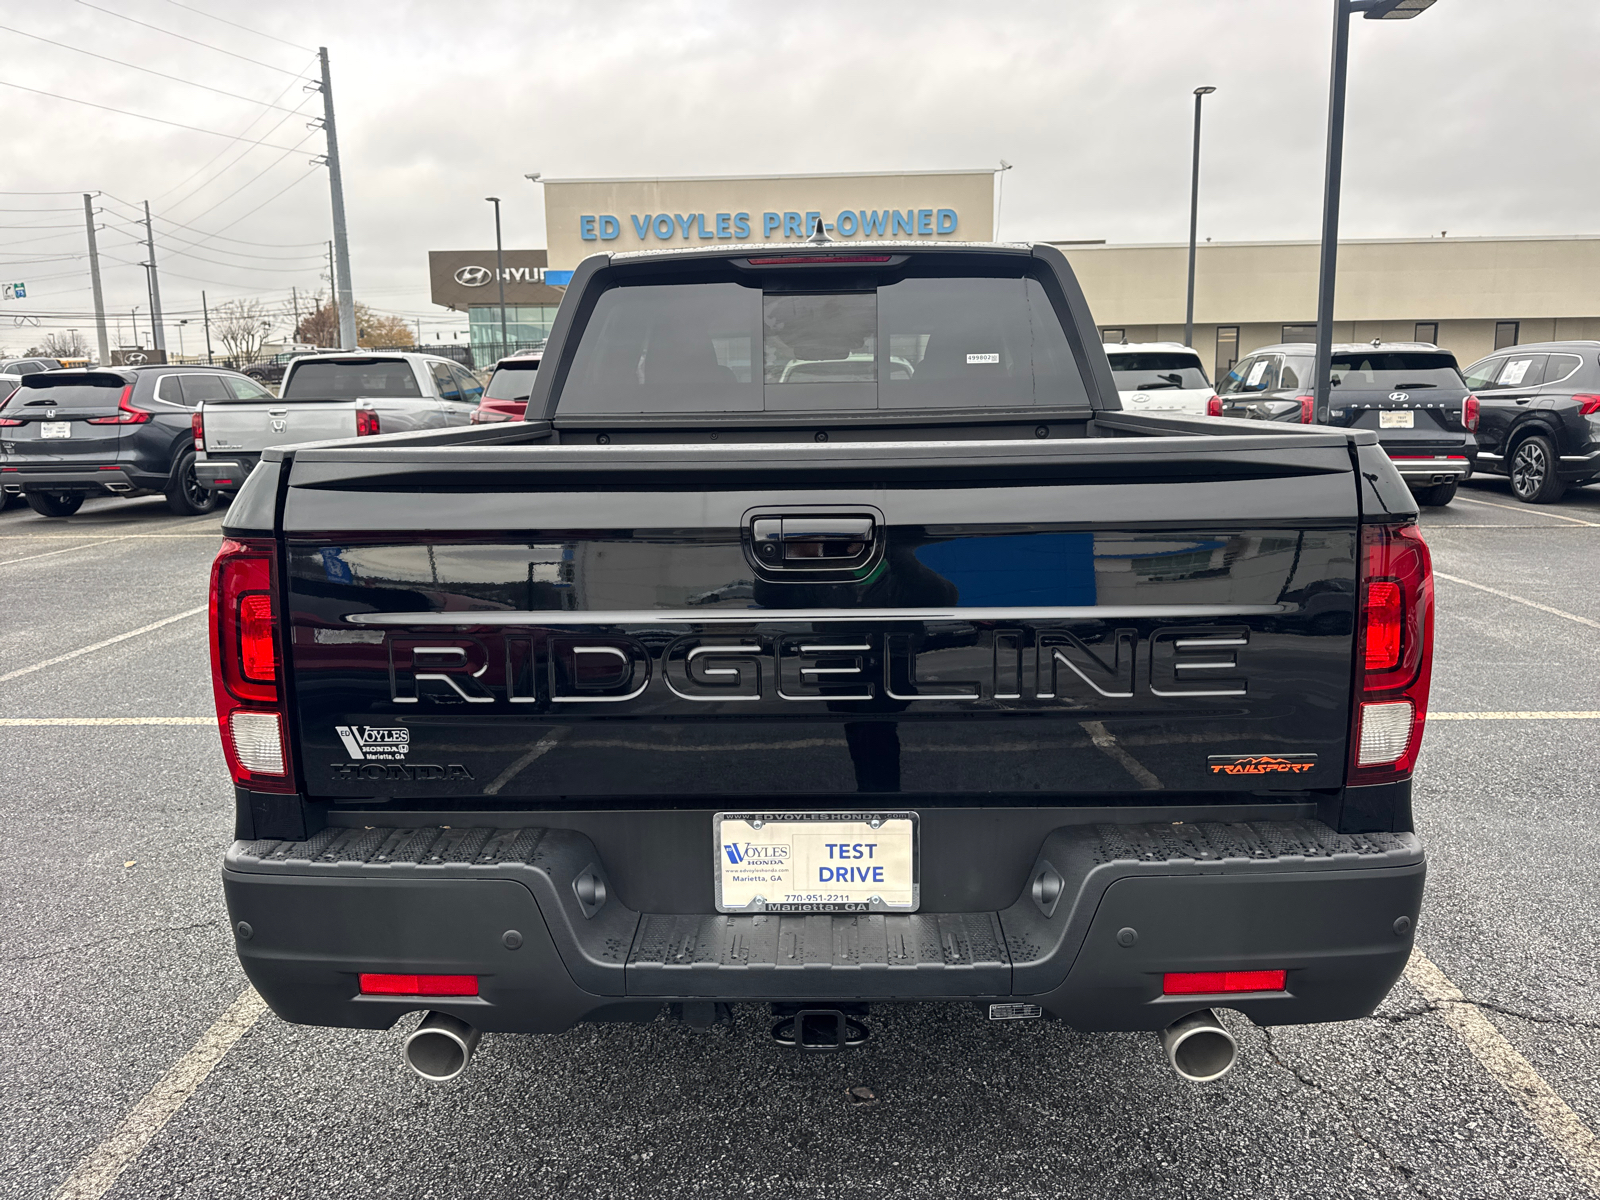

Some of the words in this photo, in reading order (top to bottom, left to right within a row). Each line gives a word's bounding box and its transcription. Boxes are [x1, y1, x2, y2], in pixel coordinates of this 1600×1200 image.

[580, 215, 620, 241] ED
[631, 212, 751, 239] VOYLES
[763, 208, 959, 238] PRE-OWNED
[387, 625, 1250, 703] RIDGELINE
[351, 726, 410, 746] VOYLES
[330, 763, 476, 781] HONDA
[1211, 763, 1315, 775] TRAILSPORT
[731, 843, 788, 862] VOYLES
[825, 843, 877, 859] TEST
[819, 866, 884, 882] DRIVE
[784, 894, 849, 902] 770-951-2211
[768, 903, 839, 912] Marietta,
[845, 903, 867, 911] GA
